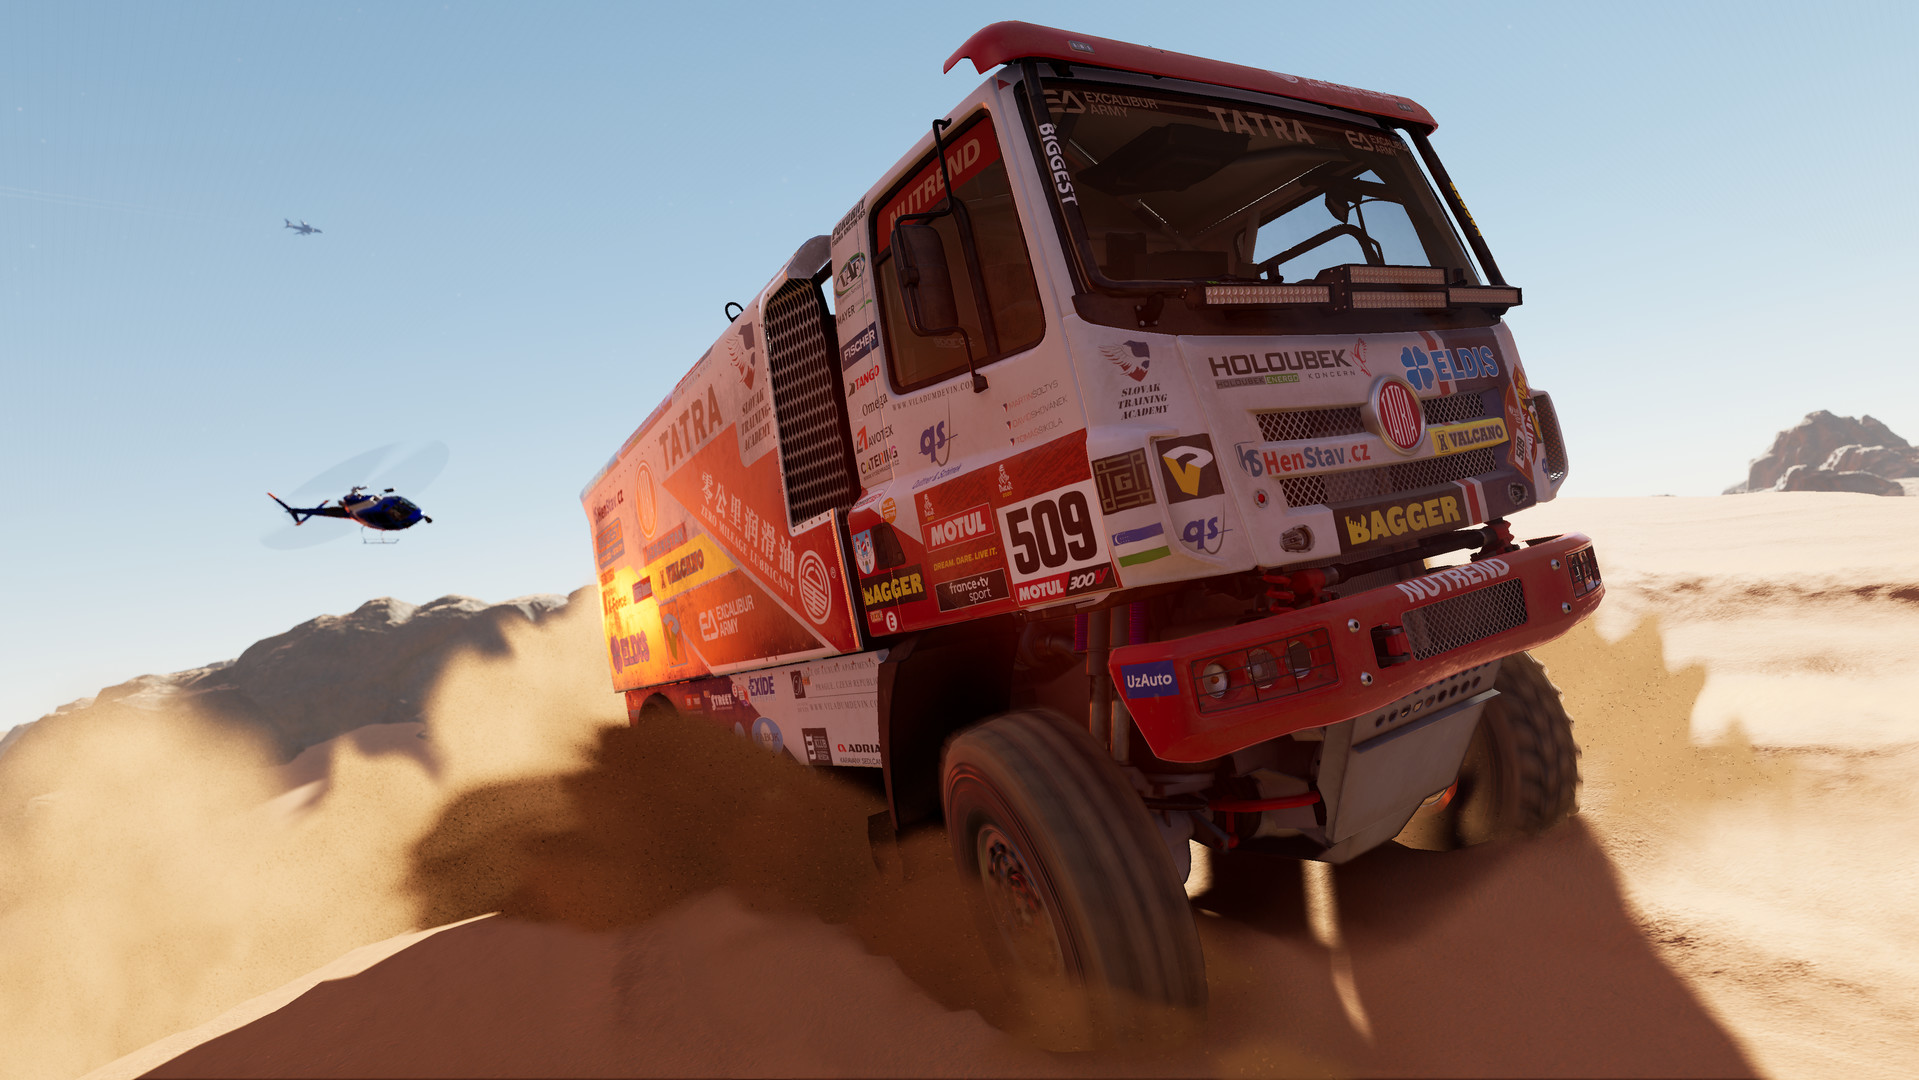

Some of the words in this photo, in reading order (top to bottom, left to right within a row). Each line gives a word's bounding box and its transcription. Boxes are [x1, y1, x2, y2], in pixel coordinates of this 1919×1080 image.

[1084, 91, 1159, 110] EXCALIBUR
[1090, 104, 1128, 118] ARMY
[1207, 106, 1315, 145] TATRA
[1039, 122, 1078, 206] BIGGEST
[843, 329, 876, 361] FISCHER
[854, 364, 881, 391] TANGO
[1208, 349, 1352, 377] HOLOUBEK
[1307, 370, 1356, 380] KONCERN
[1429, 345, 1499, 381] ELDIS
[1120, 382, 1161, 398] SLOVAK
[1216, 375, 1266, 389] HOLOUBEK
[1266, 374, 1300, 385] ENERGO
[742, 387, 764, 416] SLOVAK
[862, 393, 888, 417] Omega
[1117, 393, 1168, 410] TRAINING
[1120, 404, 1169, 421] ACADEMY
[1381, 385, 1418, 446] TATRA
[659, 383, 723, 472] TATRA
[741, 403, 771, 436] TRAINING
[744, 421, 771, 452] ACADEMY
[1449, 424, 1504, 447] VALCANO
[860, 445, 898, 475] CATERING
[931, 511, 987, 547] MOTUL
[1005, 490, 1098, 575] 509
[1346, 495, 1462, 545] BAGGER
[700, 503, 717, 528] ZERO
[719, 520, 748, 557] MILEAGE
[750, 549, 795, 597] LUBRICANT
[665, 549, 705, 586] VALCANO
[1396, 558, 1511, 603] NUTREND
[862, 572, 924, 606] BAGGER
[968, 587, 992, 604] sport
[1018, 579, 1064, 601] MOTUL
[1069, 567, 1110, 590] 300V
[715, 594, 755, 621] EXCALIBUR
[720, 617, 739, 638] ARMY
[620, 631, 650, 667] ELDIS
[748, 675, 775, 697] EXIDE
[1126, 672, 1172, 689] UzAuto
[848, 743, 882, 754] ADRIA
